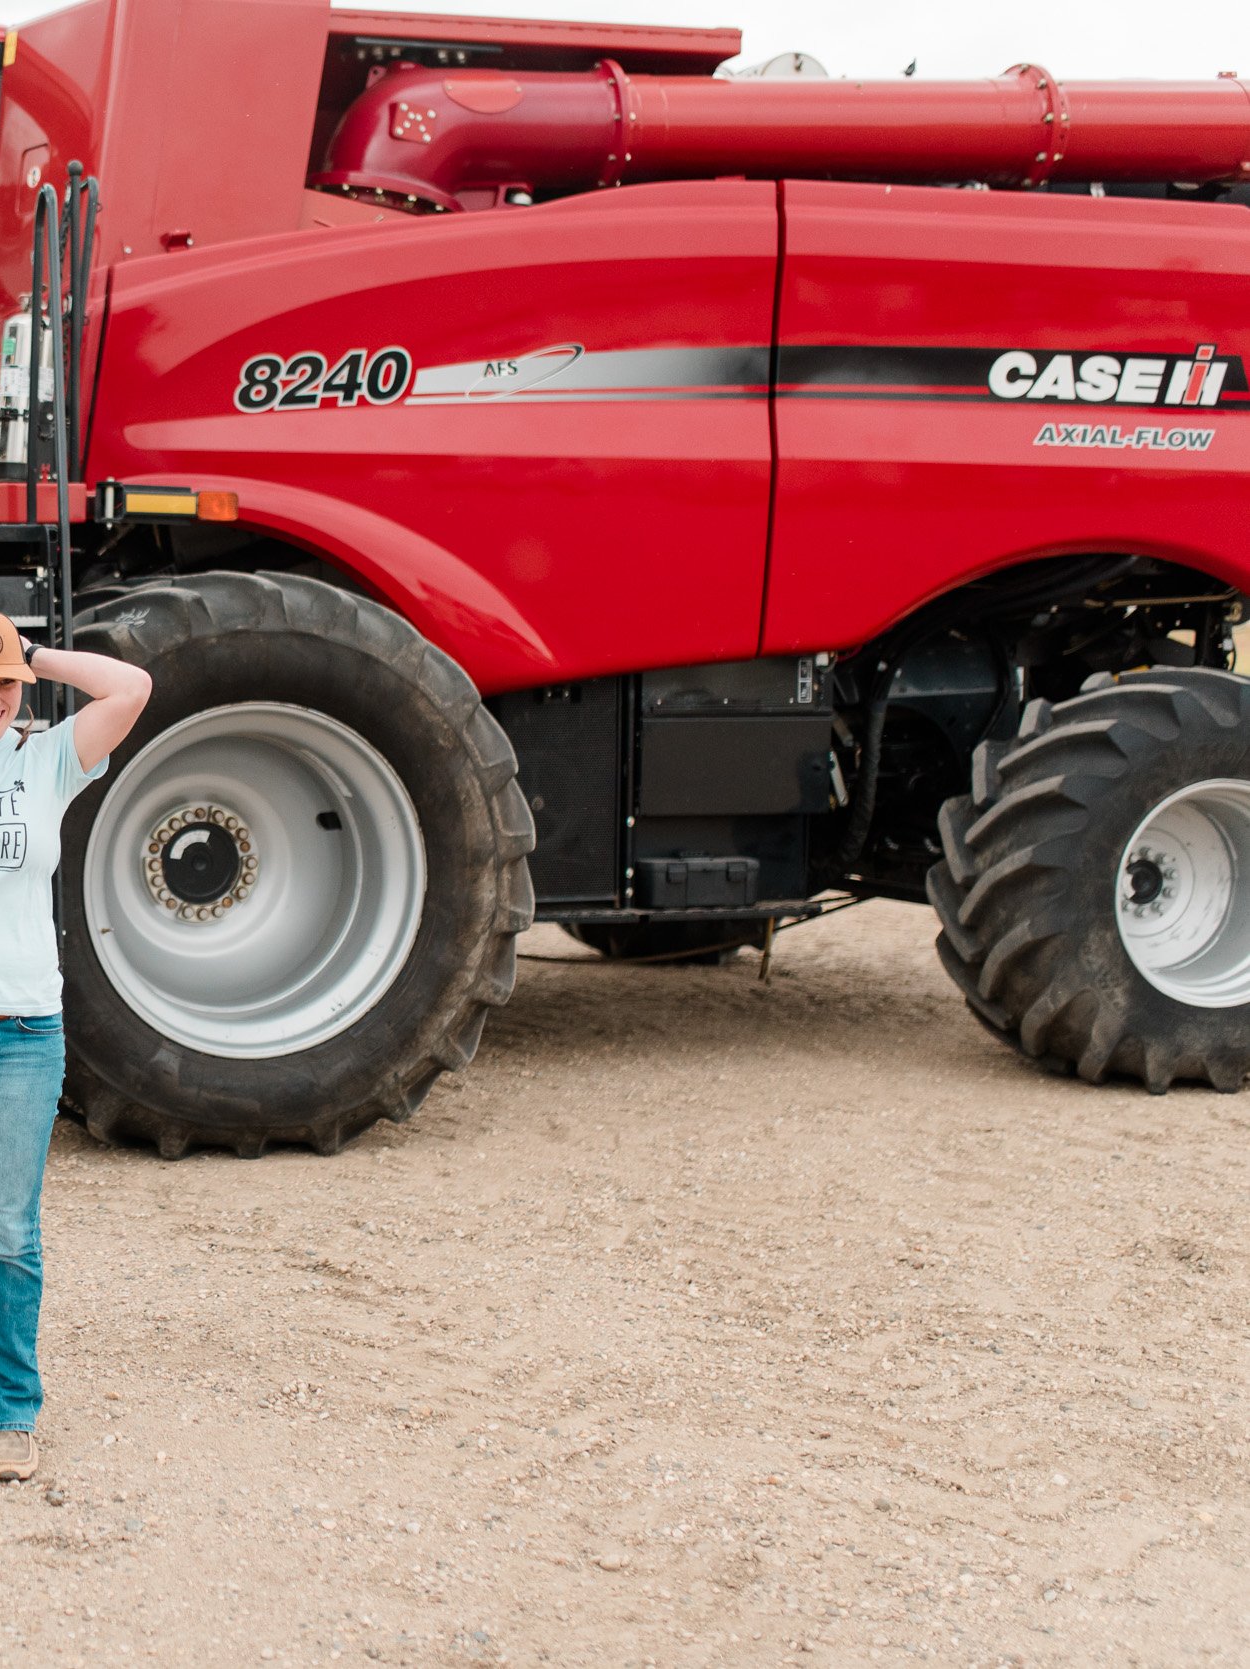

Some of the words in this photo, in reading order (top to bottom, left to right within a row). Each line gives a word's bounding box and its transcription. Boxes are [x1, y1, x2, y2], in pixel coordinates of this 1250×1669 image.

[234, 345, 412, 414] 8240
[483, 361, 519, 378] AFS
[1034, 423, 1216, 450] AXIAL-FLOW
